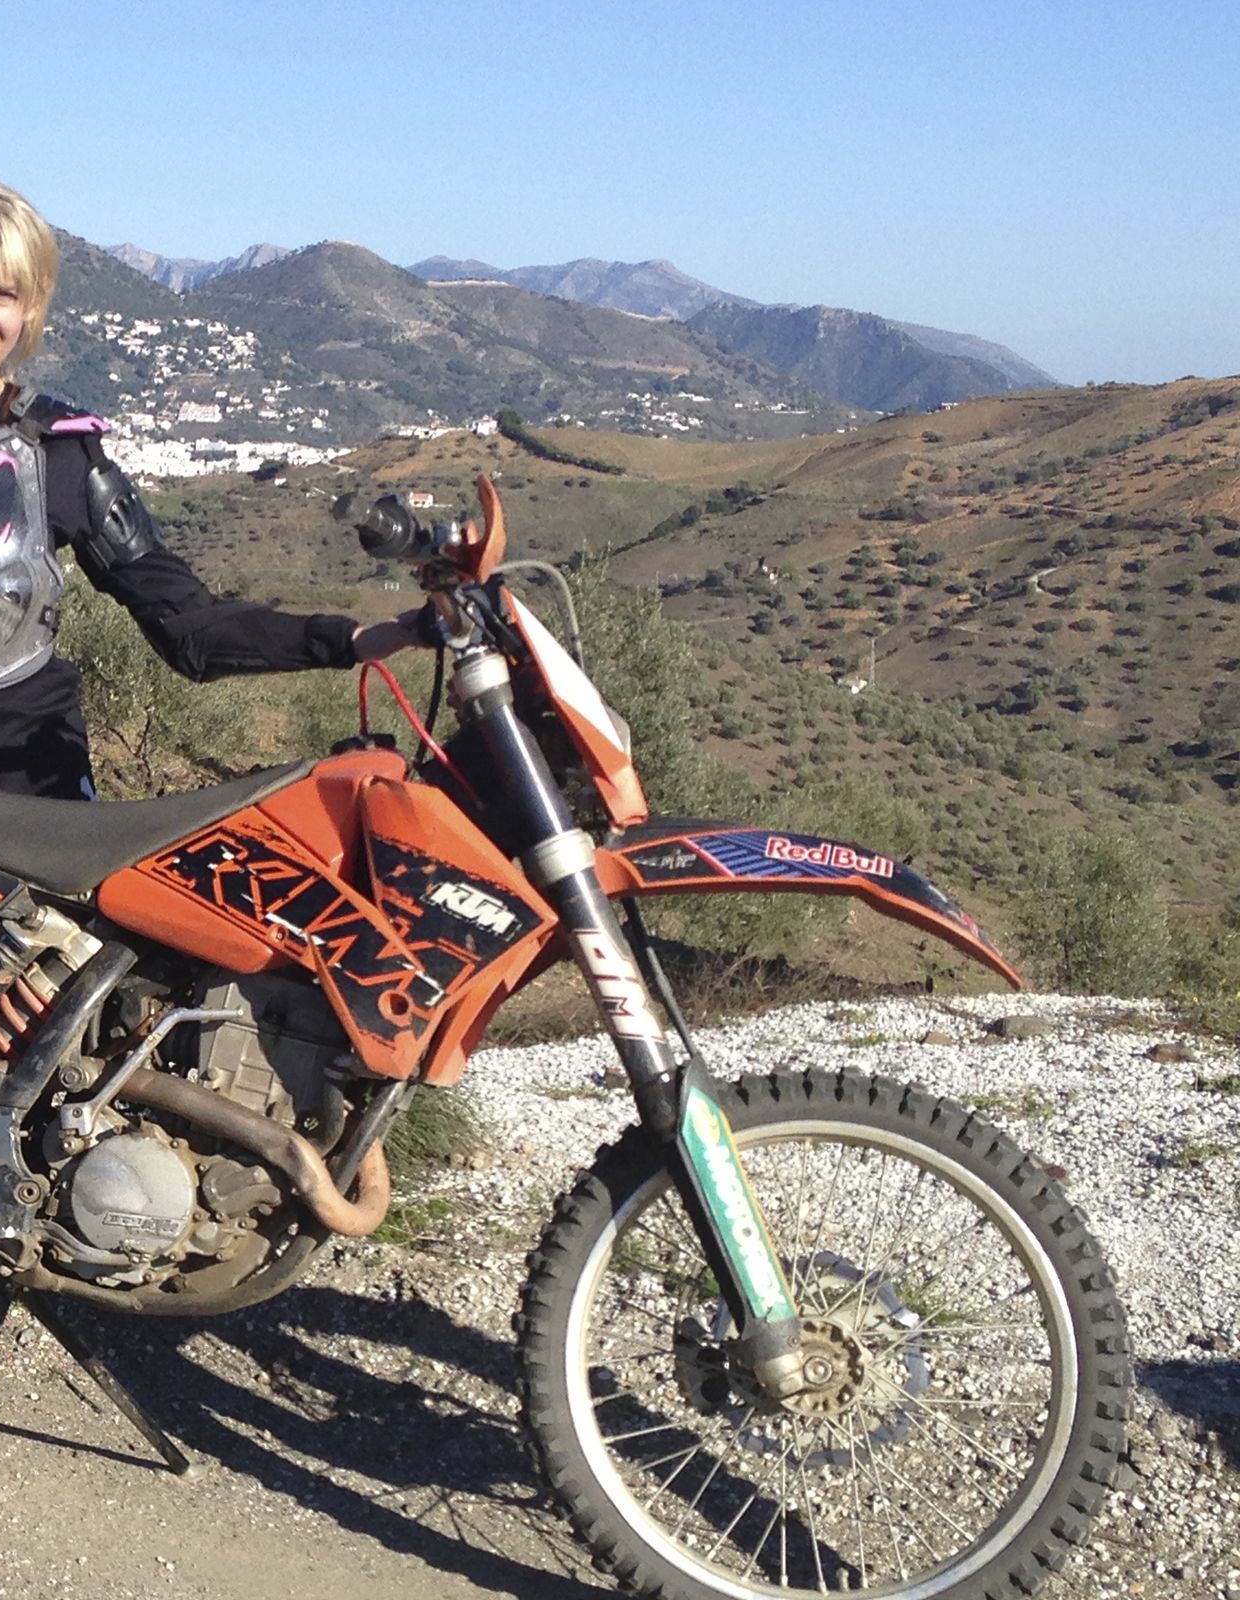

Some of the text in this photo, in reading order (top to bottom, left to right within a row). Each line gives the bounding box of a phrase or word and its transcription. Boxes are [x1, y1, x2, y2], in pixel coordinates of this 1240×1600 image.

[764, 836, 894, 878] Red Bull
[429, 882, 516, 934] KTM
[703, 1145, 785, 1307] MOTOREX
